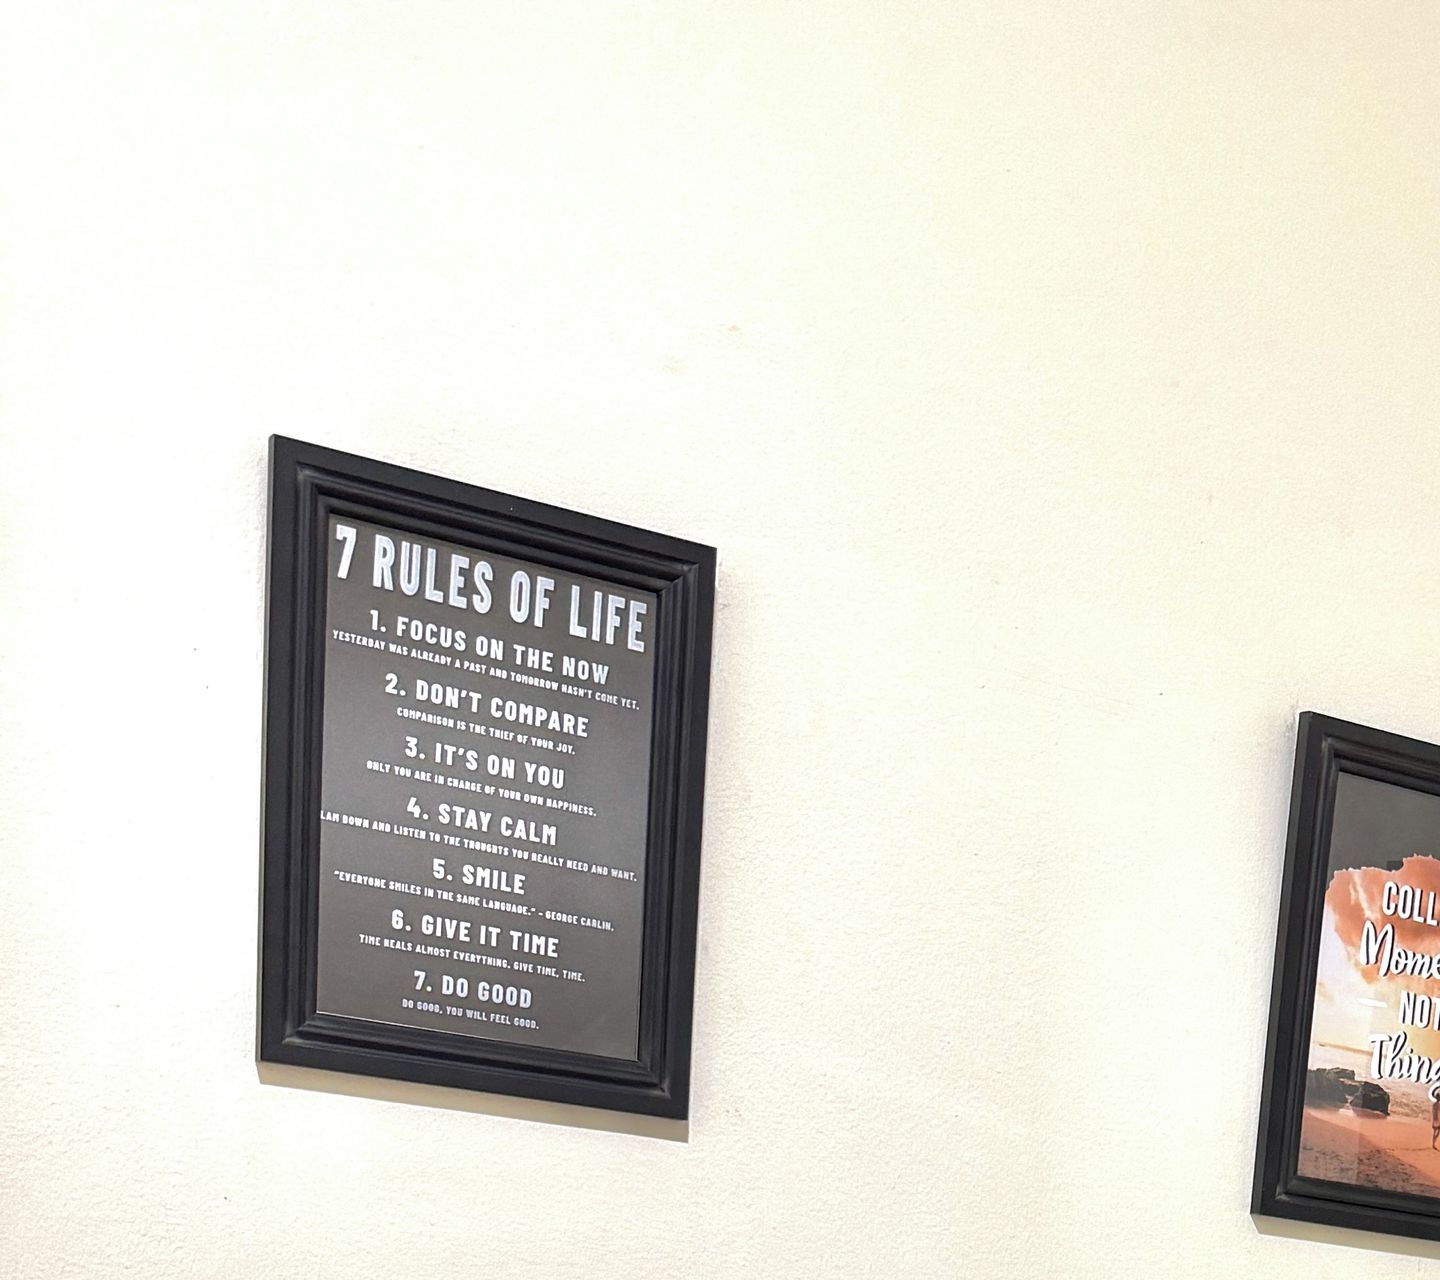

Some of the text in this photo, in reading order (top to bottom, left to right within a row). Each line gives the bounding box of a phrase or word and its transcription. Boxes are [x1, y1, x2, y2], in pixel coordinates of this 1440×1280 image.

[336, 524, 648, 653] 7 RULES OF LIFE
[332, 629, 386, 651] YESTERDAY
[388, 642, 409, 656] WAS
[410, 648, 452, 667] ALREADY
[454, 658, 461, 669] A
[463, 660, 487, 675] PAST
[489, 667, 508, 680] AND
[510, 671, 559, 691] TOMORROW
[595, 692, 618, 705] COME
[620, 697, 640, 711] YET.
[370, 609, 609, 685] 1. FOCUS ON THE NOW
[385, 672, 589, 738] 2. DON'T COMPARE
[396, 707, 576, 755] COMPARISON IS THE THIEF OF YOUR JOY.
[404, 735, 565, 789] 3. IT'S ON YOU
[366, 760, 597, 817] ONLY YOU ARE IN CHARGE OF YOUR OWN HAPPINESS.
[406, 796, 557, 846] 4. STAY CALM
[342, 814, 370, 829] DOWN
[371, 820, 391, 833] AND
[393, 824, 427, 840] LISTEN
[428, 831, 441, 843] TO
[443, 834, 461, 847] THE
[463, 838, 509, 856] THOUGHTS
[511, 848, 529, 860] YOU
[531, 852, 564, 867] REALLY
[566, 859, 589, 872] NEED
[590, 864, 609, 876] AND
[611, 868, 638, 882] WANT.
[432, 858, 526, 895] 5. SMILE
[388, 880, 422, 896] SMILES
[424, 887, 435, 898] IN
[436, 889, 454, 902] THE
[456, 893, 481, 907] SAME
[545, 910, 579, 925] GEORGE
[580, 917, 614, 932] CARLIN.
[358, 933, 381, 947] TIME
[383, 938, 413, 952] HEALS
[415, 944, 451, 959] ALMOST
[453, 950, 511, 969] EVERYTHING.
[513, 961, 534, 973] GIVE
[562, 969, 586, 982] TIME.
[391, 908, 559, 958] 6. GIVE IT TIME
[402, 998, 414, 1009] DO
[446, 1006, 463, 1017] YOU
[465, 1009, 488, 1021] WILL
[490, 1013, 511, 1025] FEEL
[513, 1017, 540, 1030] GOOD.
[414, 970, 532, 1009] 7. DO GOOD
